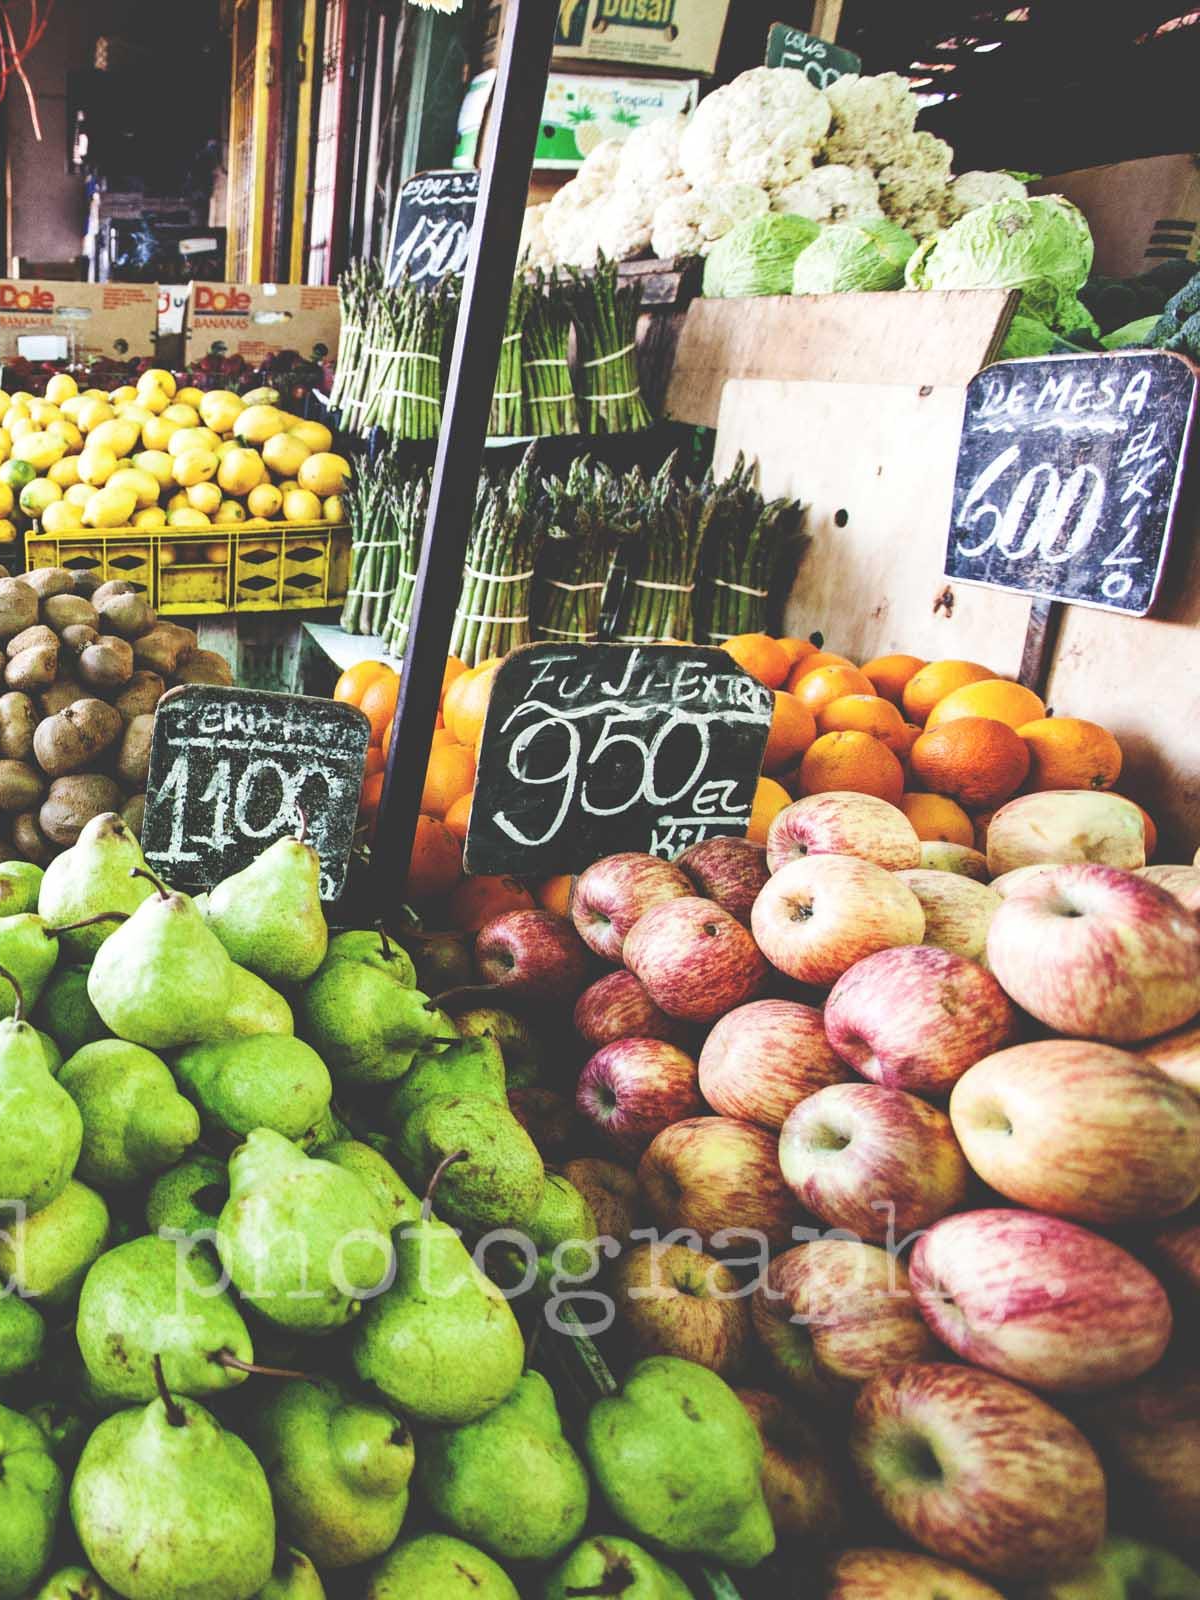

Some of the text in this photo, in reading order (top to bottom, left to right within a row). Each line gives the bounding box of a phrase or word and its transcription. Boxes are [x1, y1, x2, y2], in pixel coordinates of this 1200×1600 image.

[0, 285, 55, 309] Dole
[195, 286, 252, 311] Dole
[193, 317, 249, 329] BANANAS
[974, 370, 1152, 418] DE MESA
[956, 445, 1107, 564] 600
[492, 710, 711, 847] 950
